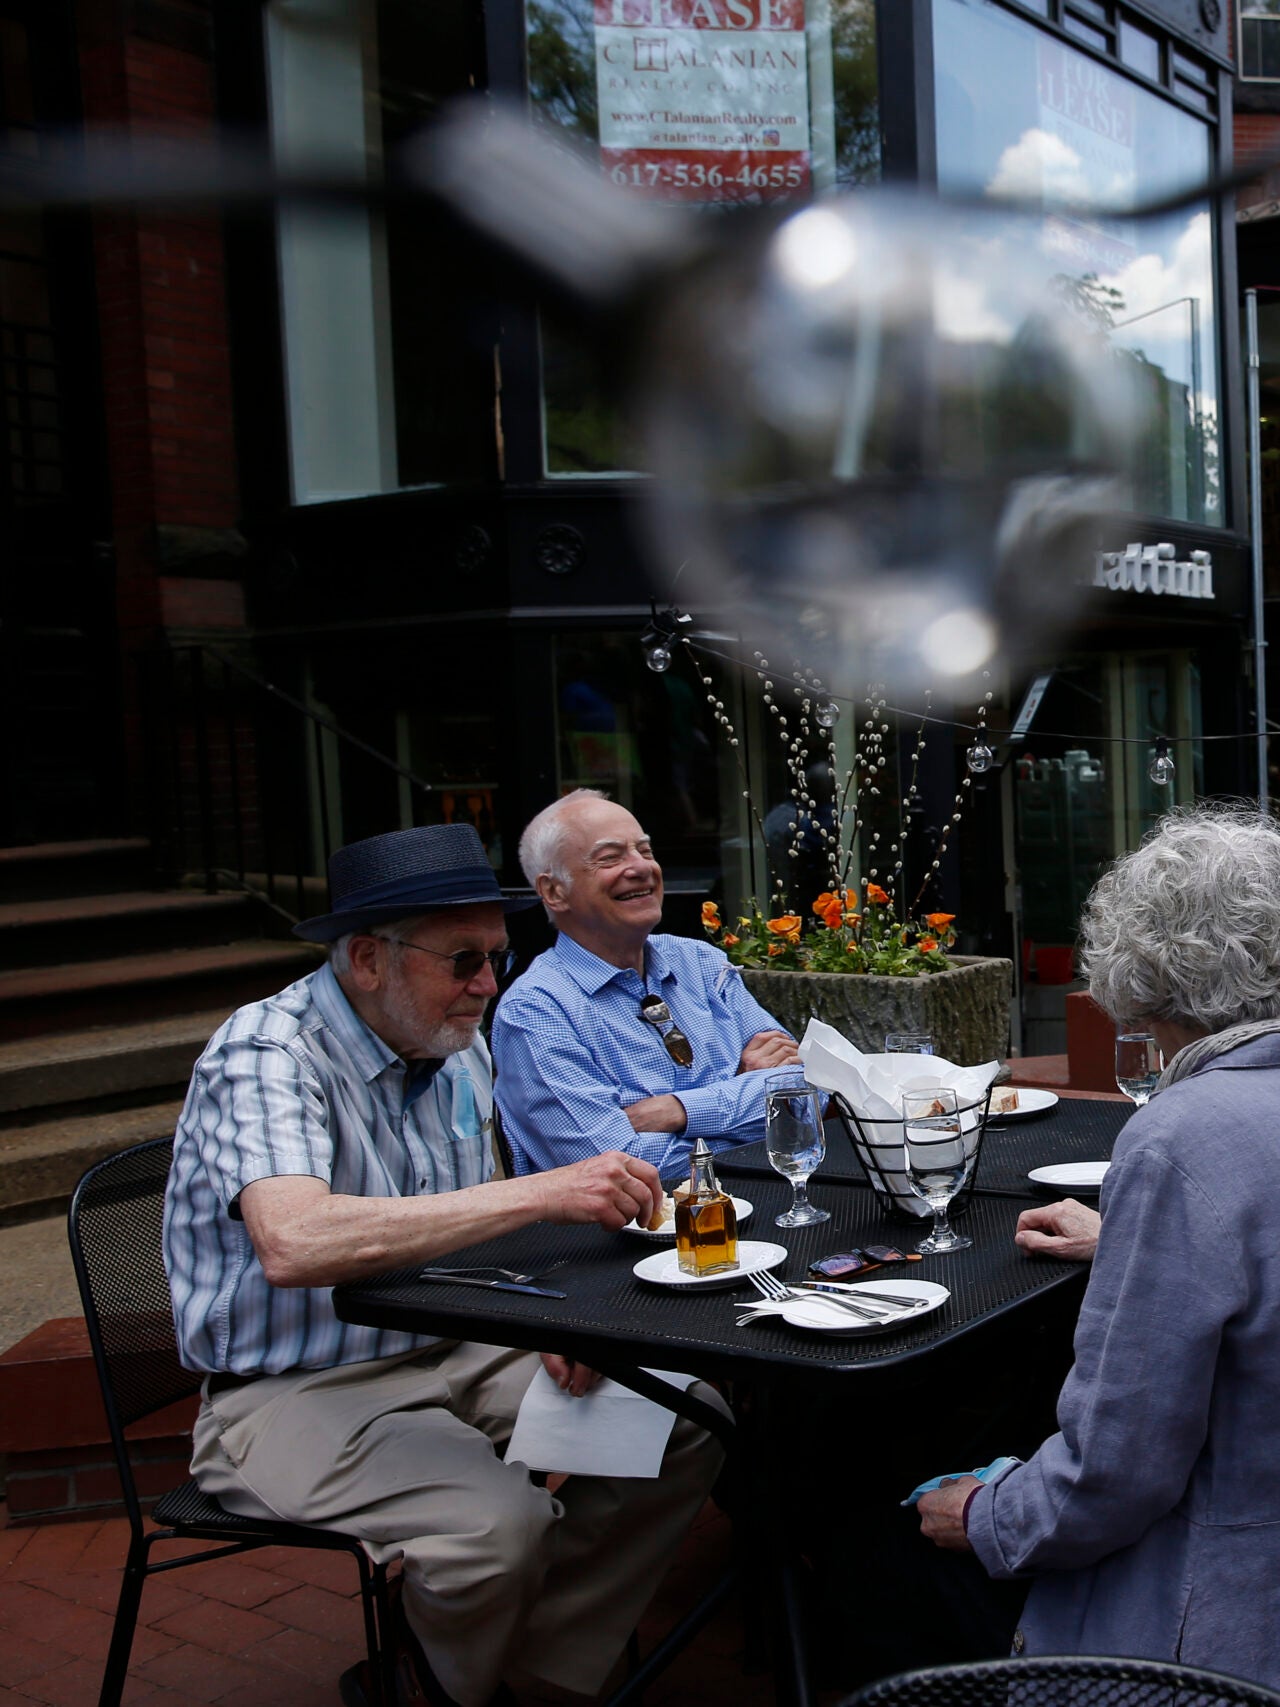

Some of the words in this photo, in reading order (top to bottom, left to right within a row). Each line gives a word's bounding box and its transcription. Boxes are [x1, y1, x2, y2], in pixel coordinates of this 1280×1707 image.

[611, 0, 792, 30] LEASE
[1047, 72, 1127, 144] LEASE
[611, 163, 801, 188] 617-536-4655
